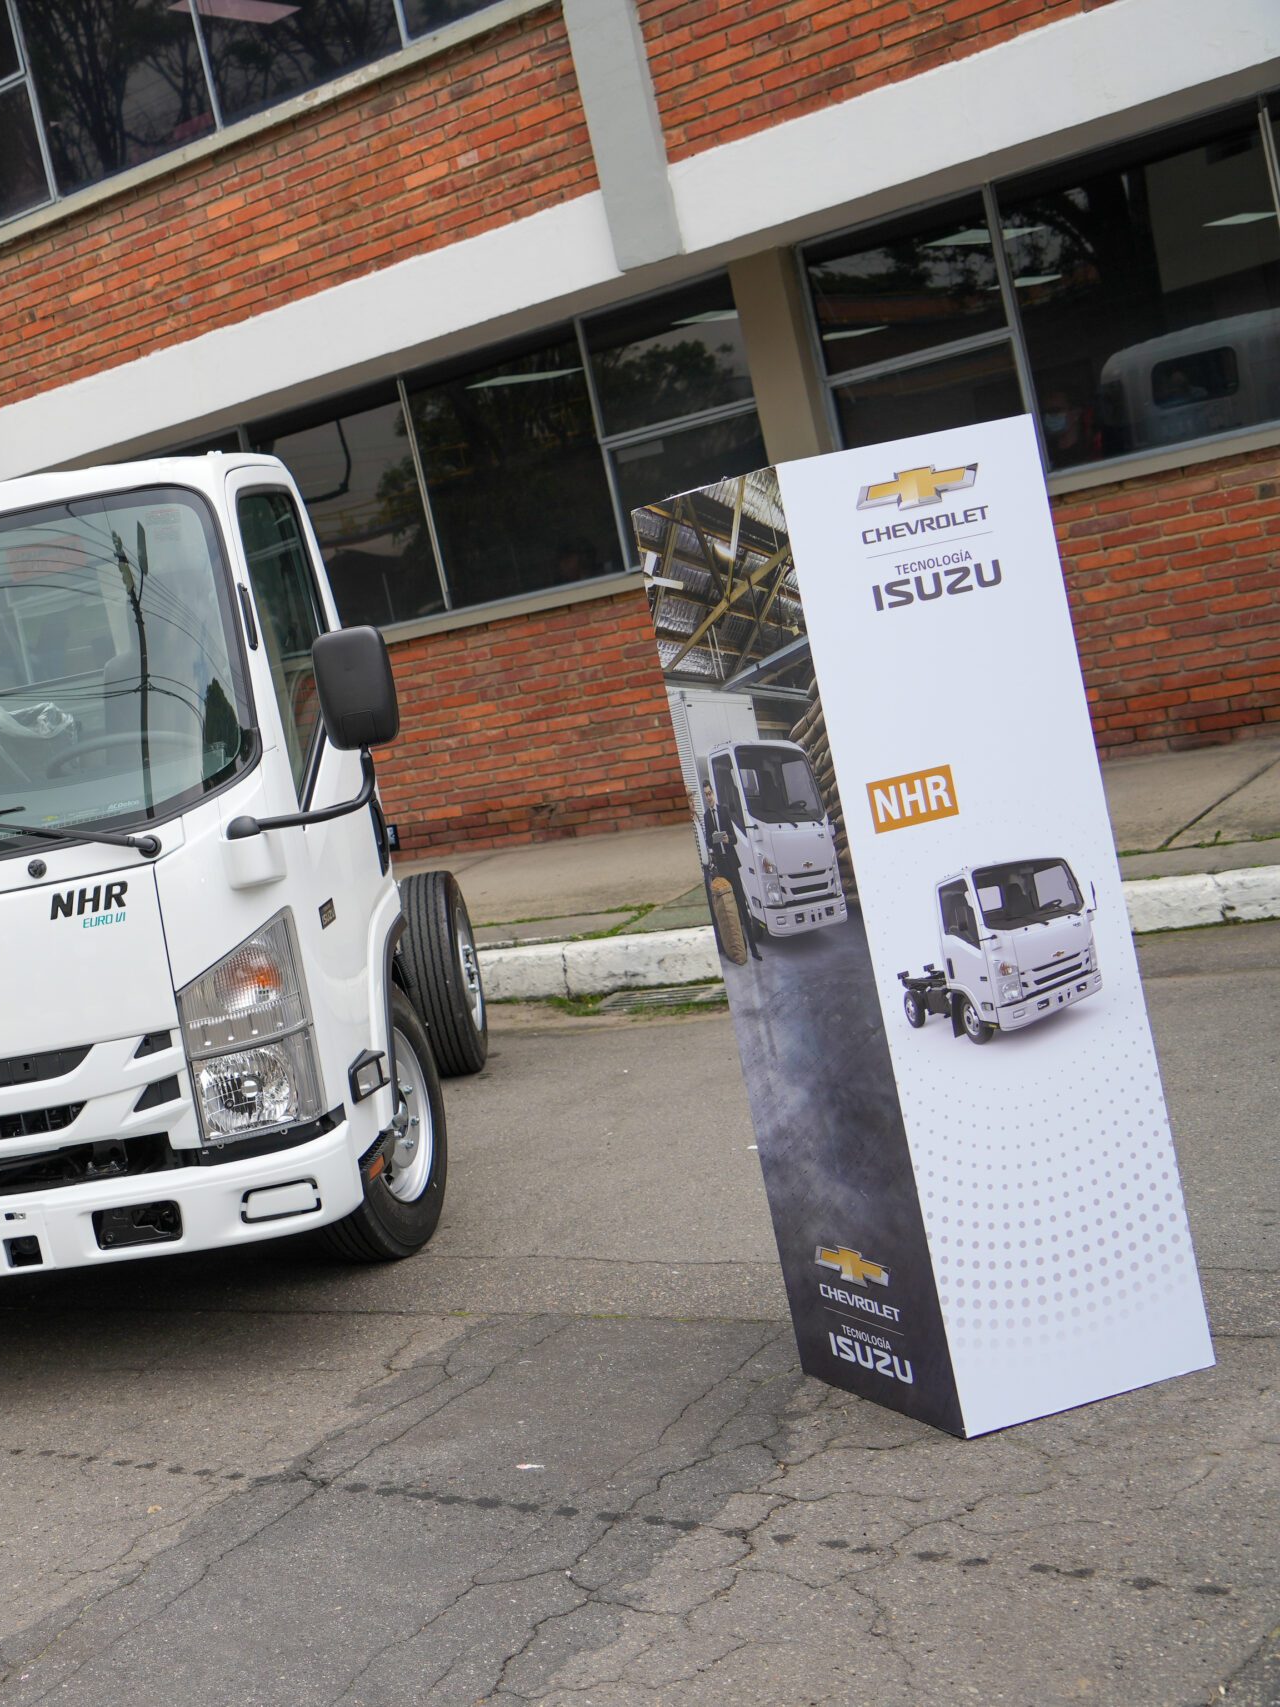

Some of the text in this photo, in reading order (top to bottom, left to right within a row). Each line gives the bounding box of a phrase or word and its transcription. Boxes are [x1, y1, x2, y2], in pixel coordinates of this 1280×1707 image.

[861, 505, 989, 545] CHEVROLET
[894, 549, 973, 576] TECNOLOGÍA
[872, 559, 1002, 612] ISUZU
[872, 774, 953, 824] NHR
[50, 880, 128, 921] NHR
[82, 913, 114, 929] EURO
[819, 1283, 901, 1322] CHEVROLET
[840, 1324, 892, 1351] TECNOLOGÍA
[828, 1331, 914, 1385] ISUZU
